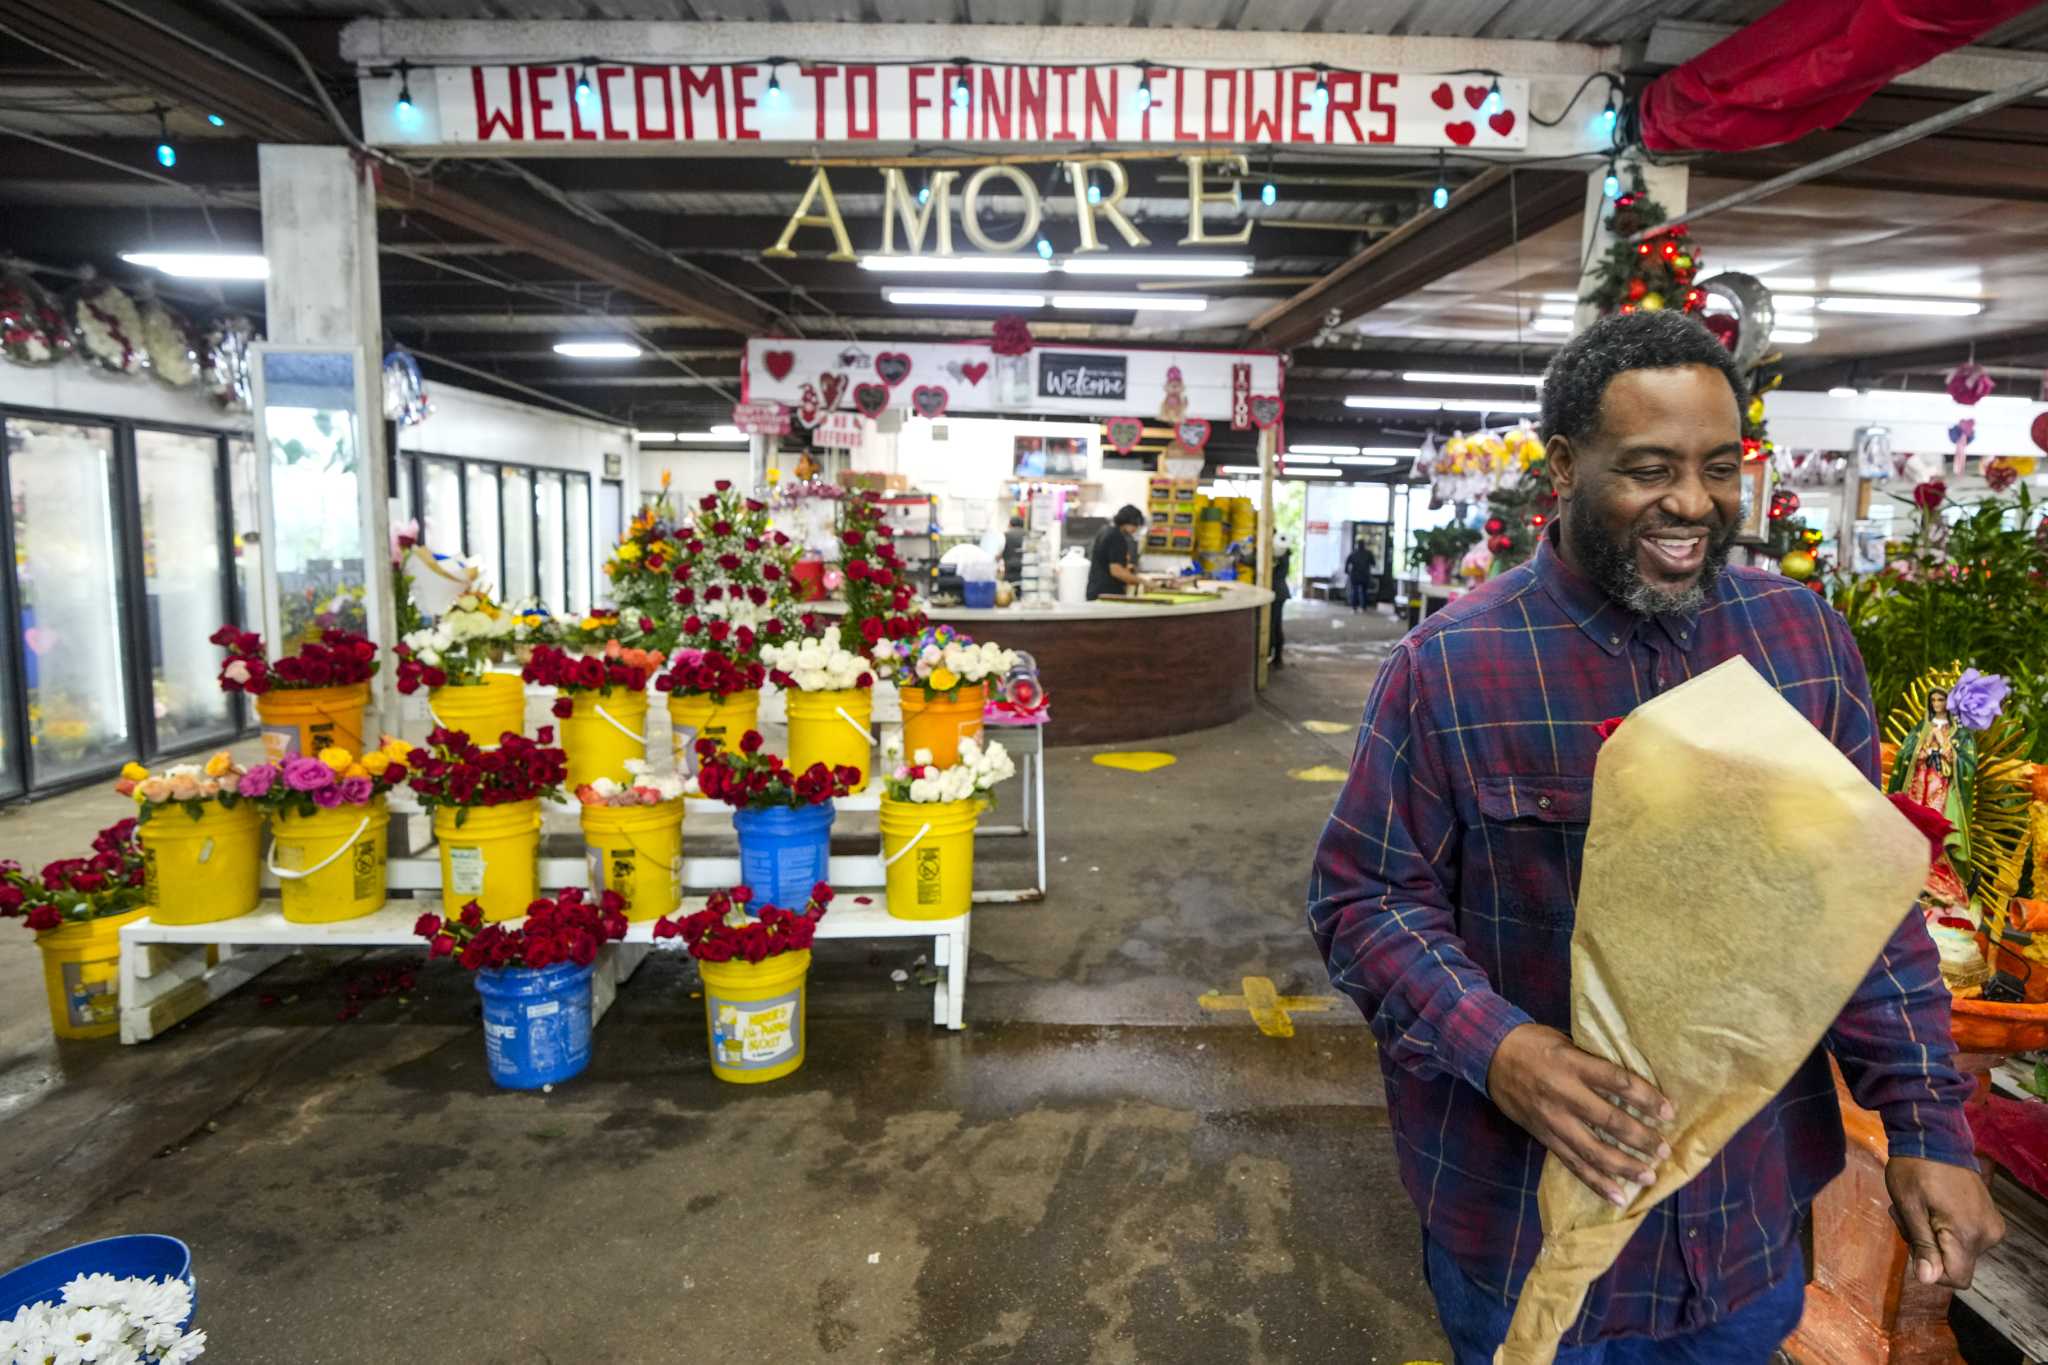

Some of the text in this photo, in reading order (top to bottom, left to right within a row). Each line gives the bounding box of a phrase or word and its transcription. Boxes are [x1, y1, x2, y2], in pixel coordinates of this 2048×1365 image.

[471, 66, 1399, 145] WELCOME TO FANNIN FLOWERS
[761, 154, 1255, 260] AMORE
[1046, 366, 1126, 396] Welcome
